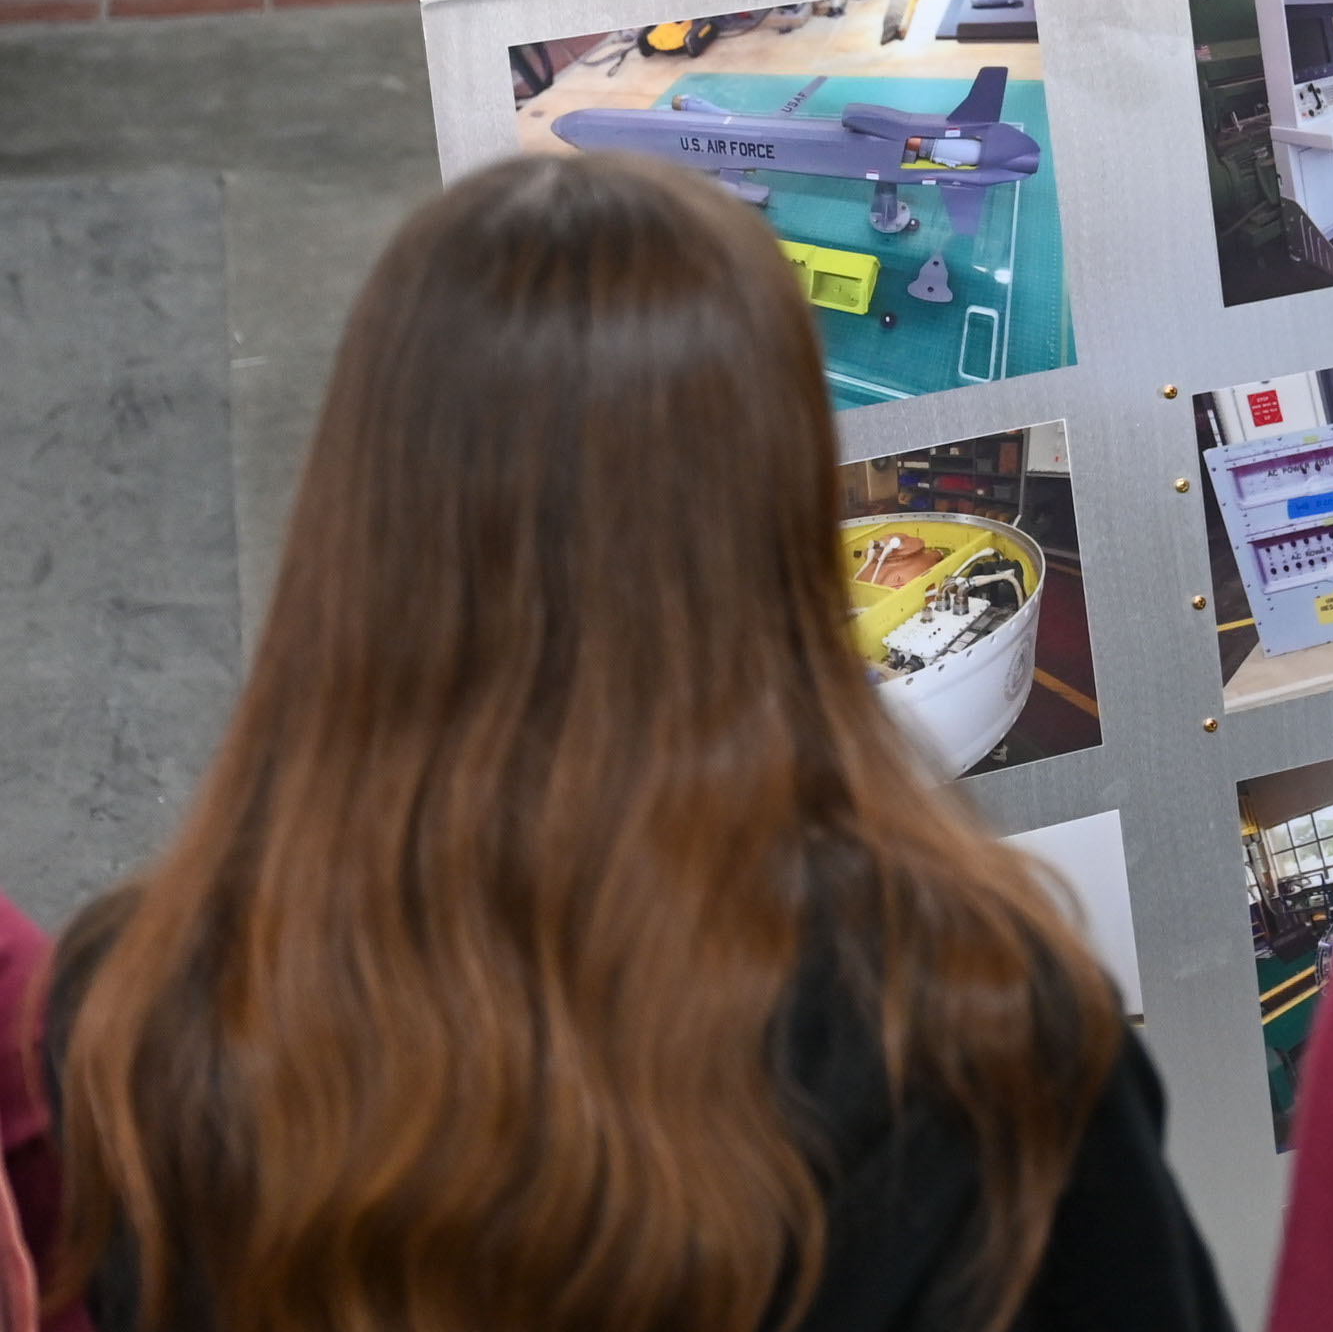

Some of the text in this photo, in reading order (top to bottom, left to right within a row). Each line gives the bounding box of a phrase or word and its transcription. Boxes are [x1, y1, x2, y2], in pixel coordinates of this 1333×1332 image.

[781, 92, 808, 113] USAF
[680, 137, 775, 159] U.S. AIR FORCE
[1267, 469, 1278, 477] AC
